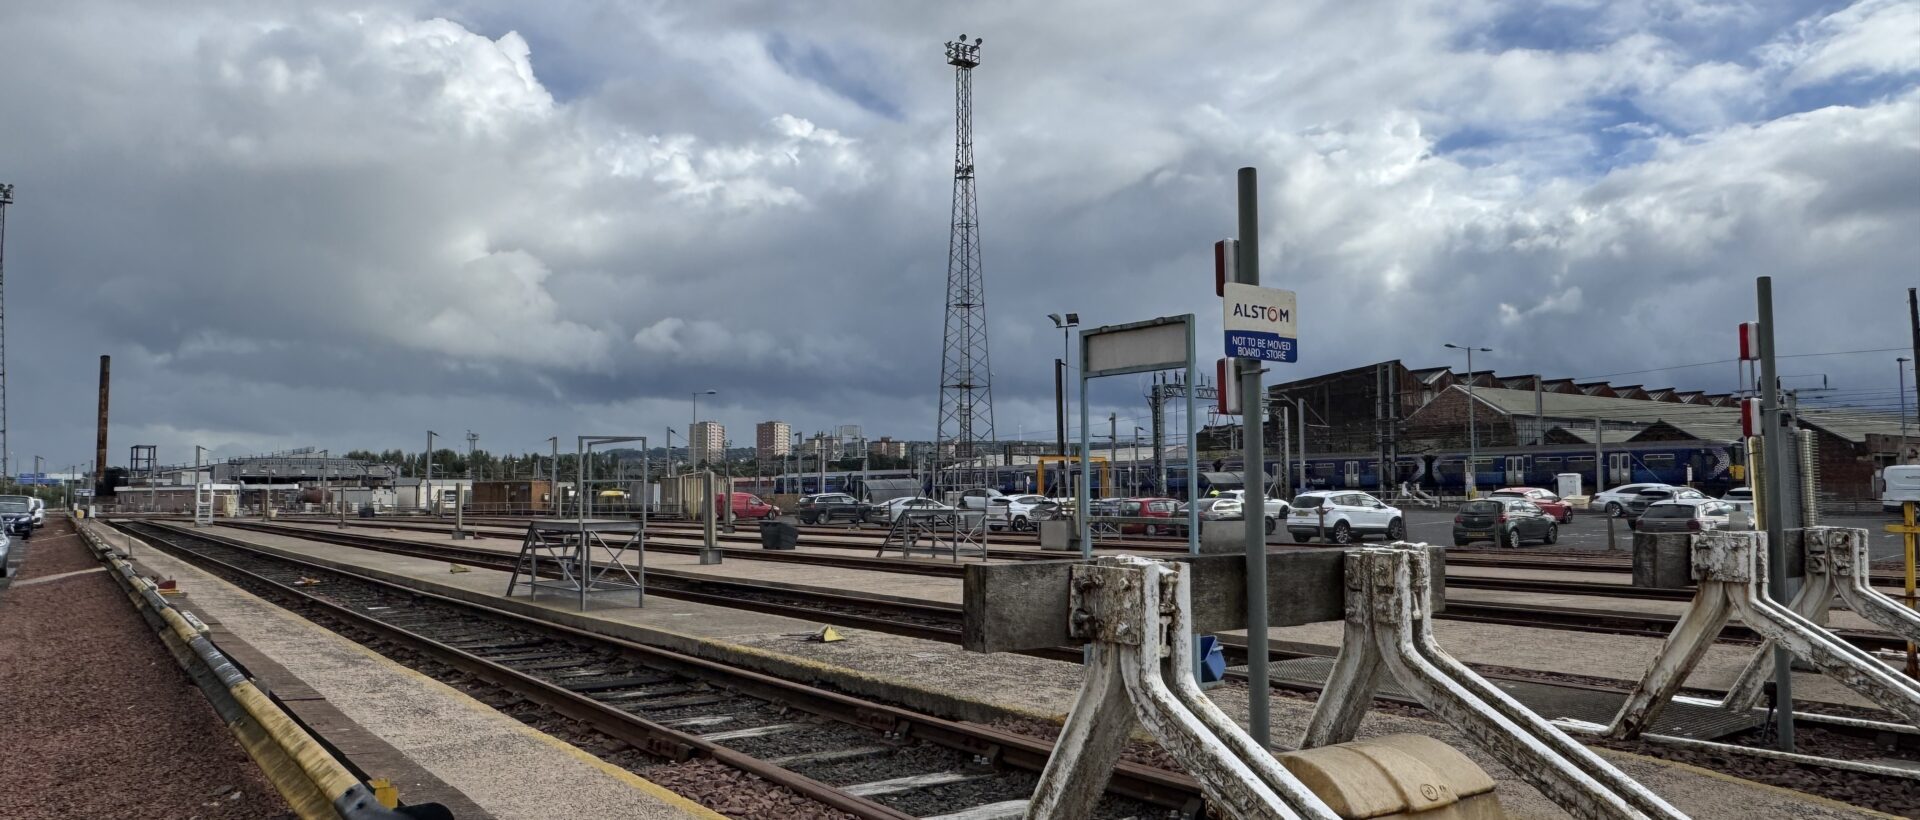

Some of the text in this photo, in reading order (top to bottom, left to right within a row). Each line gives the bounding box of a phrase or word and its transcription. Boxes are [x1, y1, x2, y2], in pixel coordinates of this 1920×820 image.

[1233, 303, 1289, 322] ALSTOM
[1232, 336, 1291, 351] NOT TO BE MOVED
[1238, 347, 1260, 357] BOARD
[1266, 350, 1286, 360] STORE
